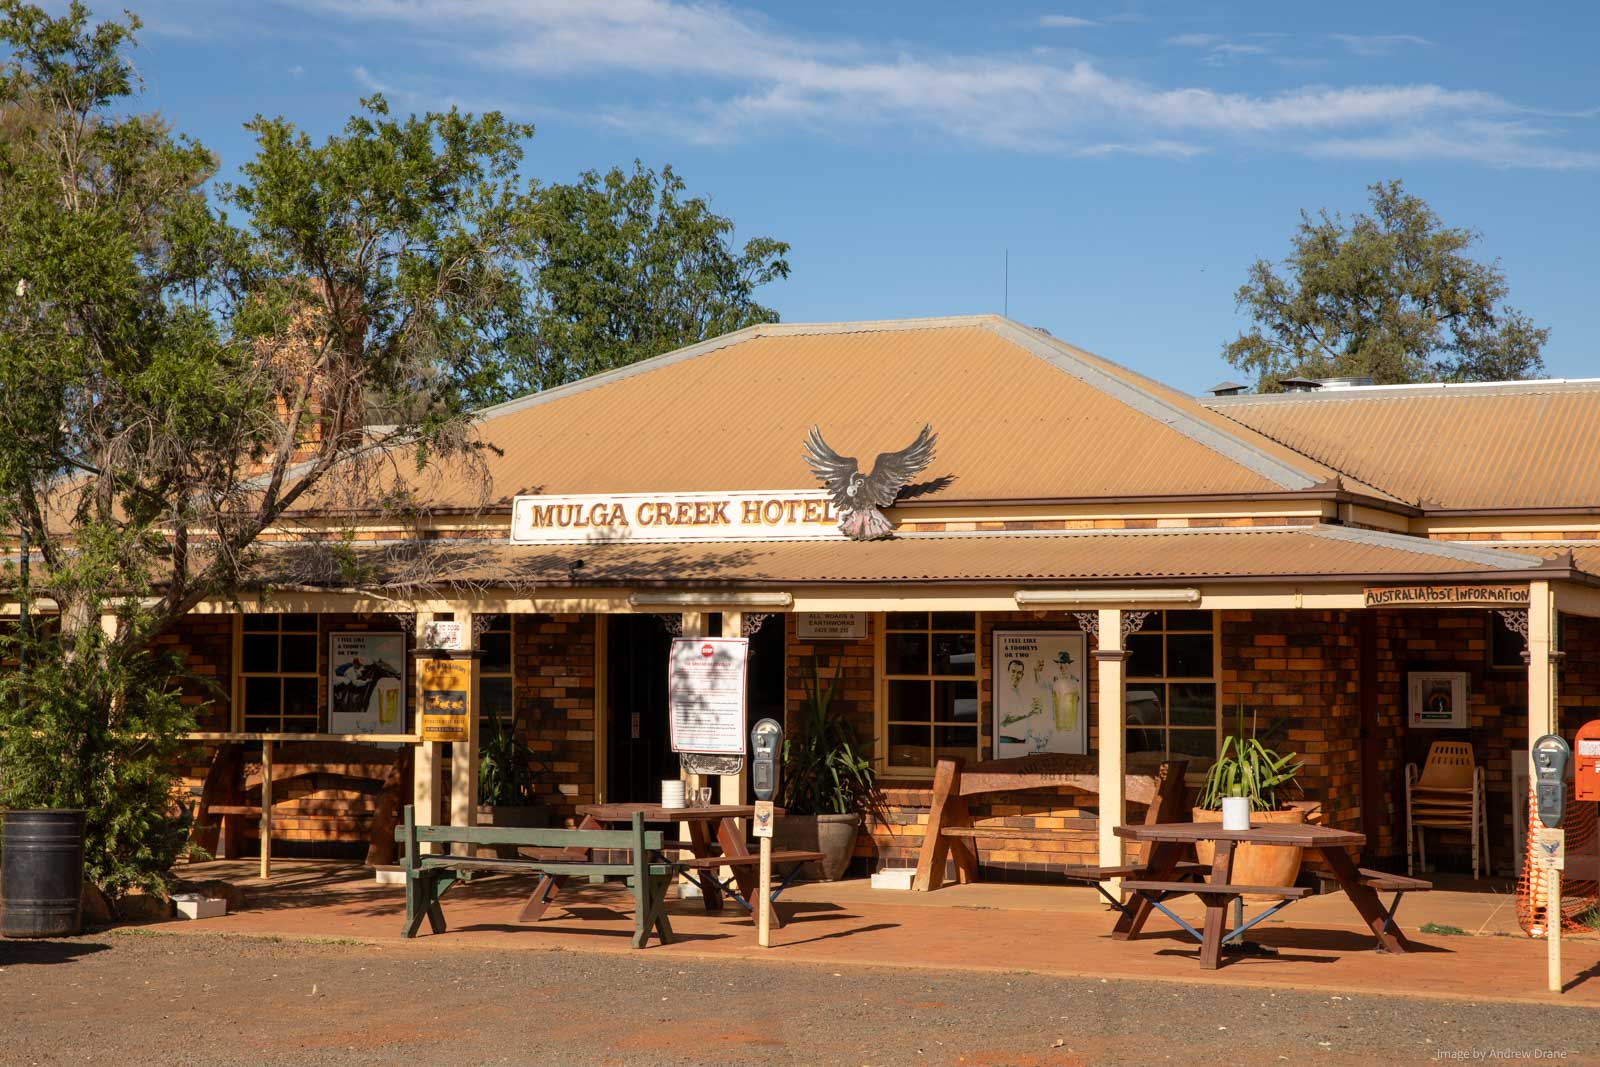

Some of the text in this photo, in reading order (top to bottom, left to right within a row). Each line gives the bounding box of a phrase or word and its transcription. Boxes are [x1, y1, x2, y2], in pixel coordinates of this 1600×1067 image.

[531, 499, 839, 528] MULGA CREEK HOTEL
[1366, 588, 1425, 604] AUSTRALIA
[1455, 587, 1530, 602] INFORMATION
